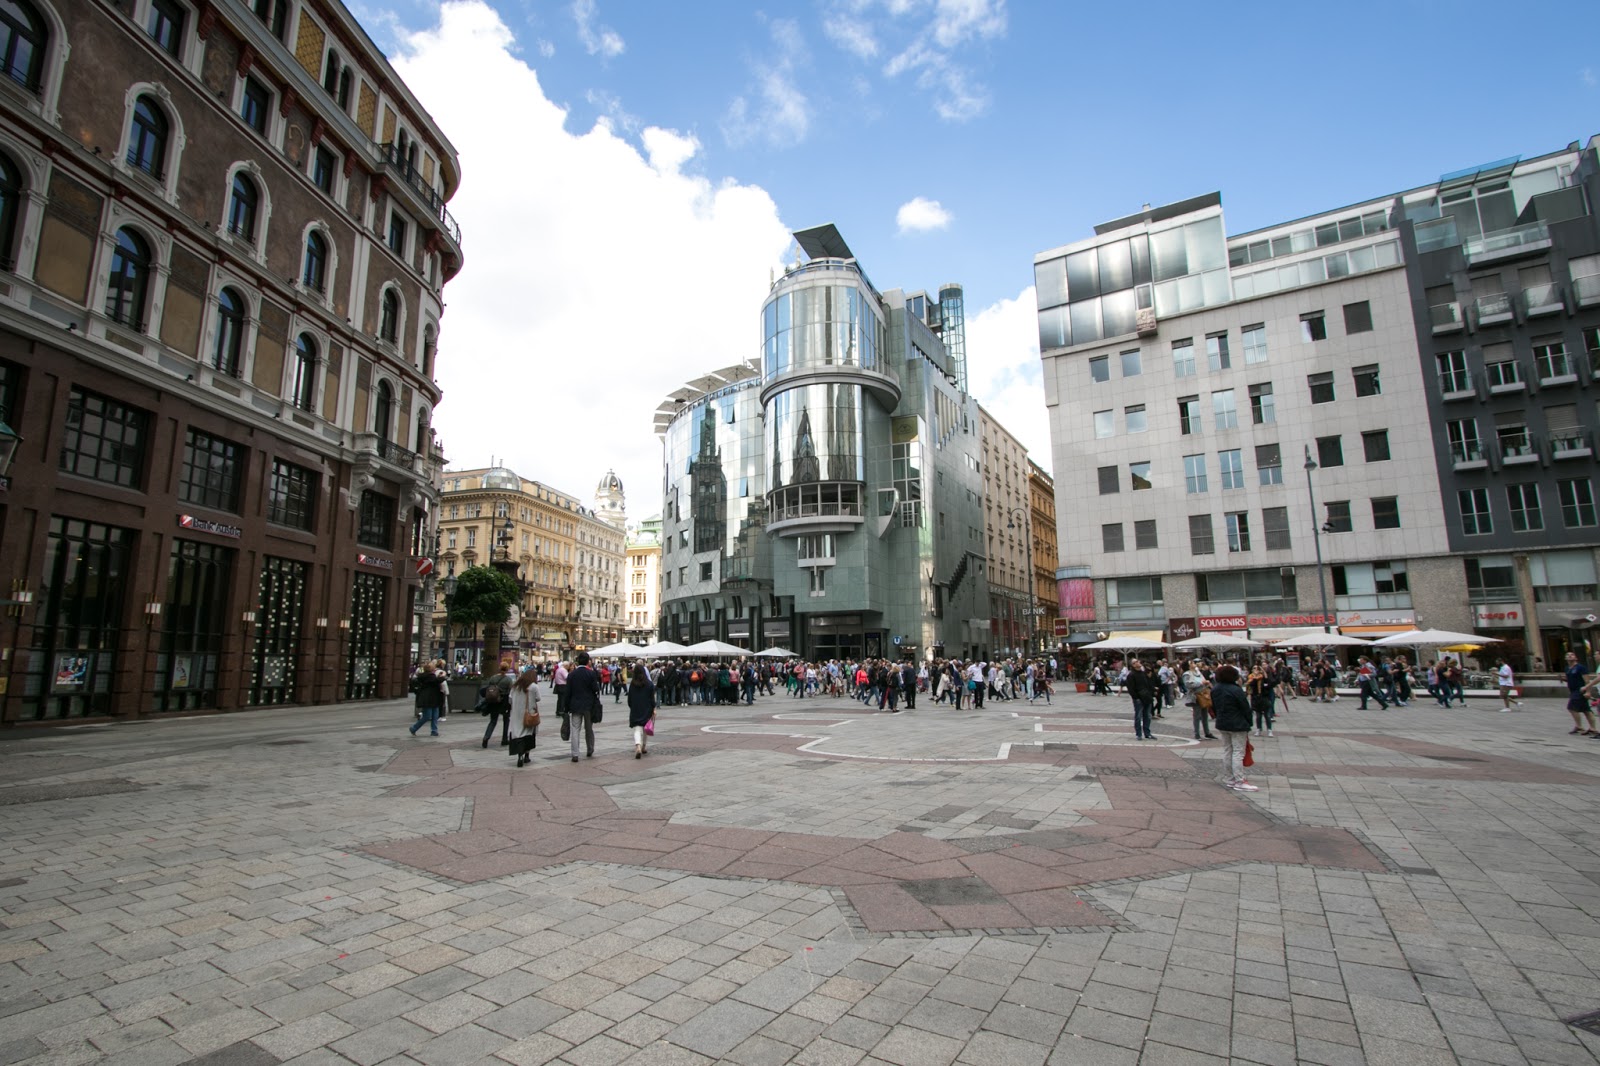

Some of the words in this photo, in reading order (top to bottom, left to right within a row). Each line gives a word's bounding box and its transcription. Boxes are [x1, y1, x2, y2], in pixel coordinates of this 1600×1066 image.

[193, 517, 214, 531] Bank
[1200, 618, 1246, 628] SOUVENIRS
[1249, 614, 1336, 626] SOUVENIRS
